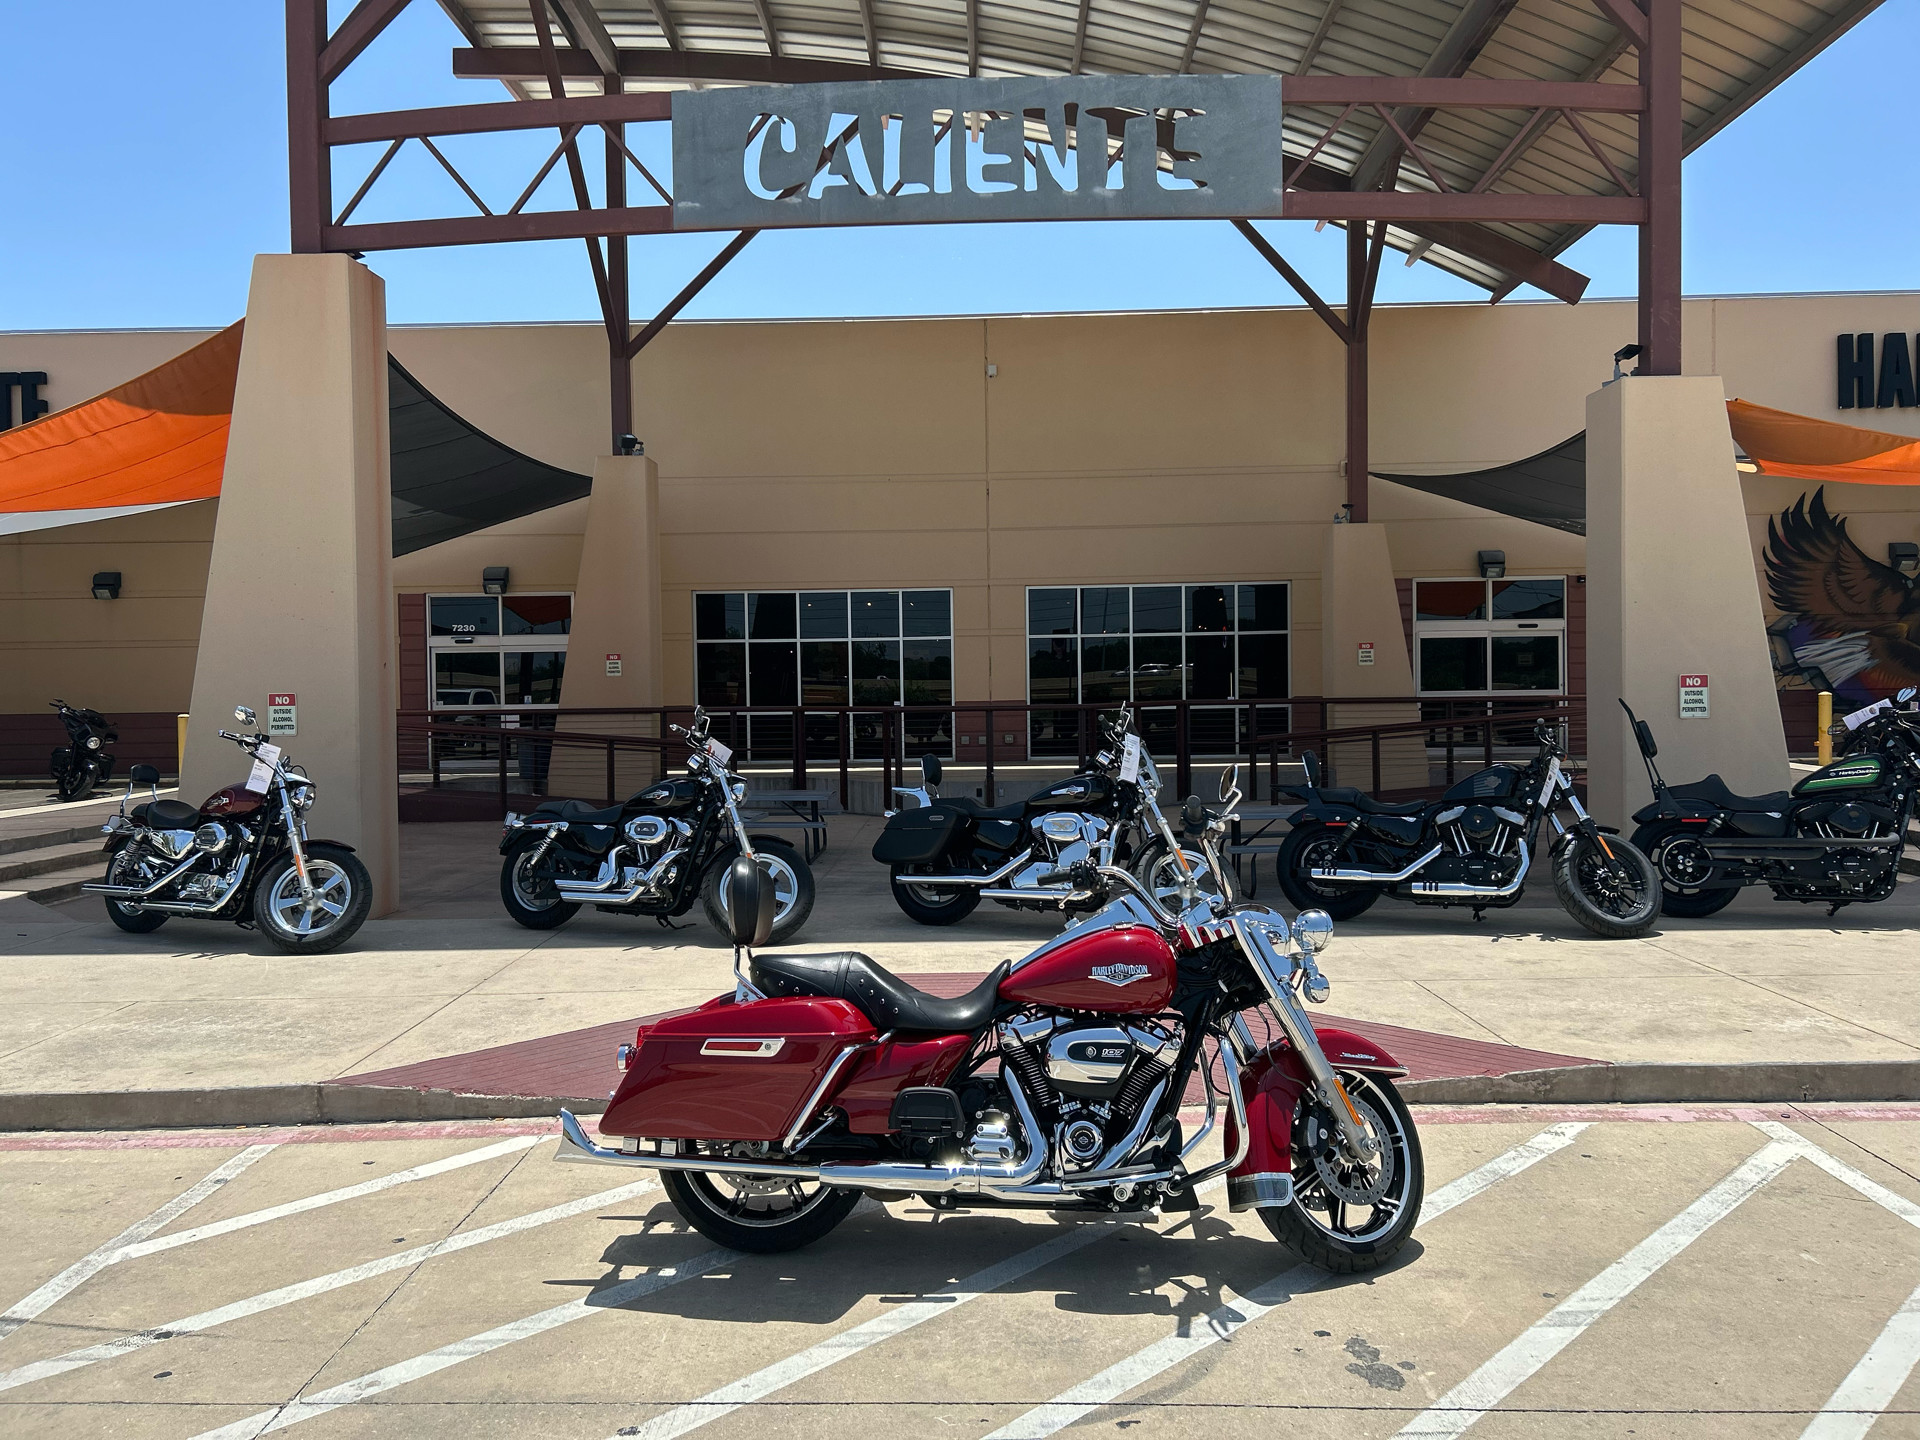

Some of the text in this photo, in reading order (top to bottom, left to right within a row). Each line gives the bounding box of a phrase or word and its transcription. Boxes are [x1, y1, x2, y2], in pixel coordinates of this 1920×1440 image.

[743, 103, 1208, 200] CALIENTE
[1837, 332, 1920, 409] HA
[452, 624, 476, 632] 7230
[1686, 677, 1701, 686] NO
[275, 696, 290, 705] NO
